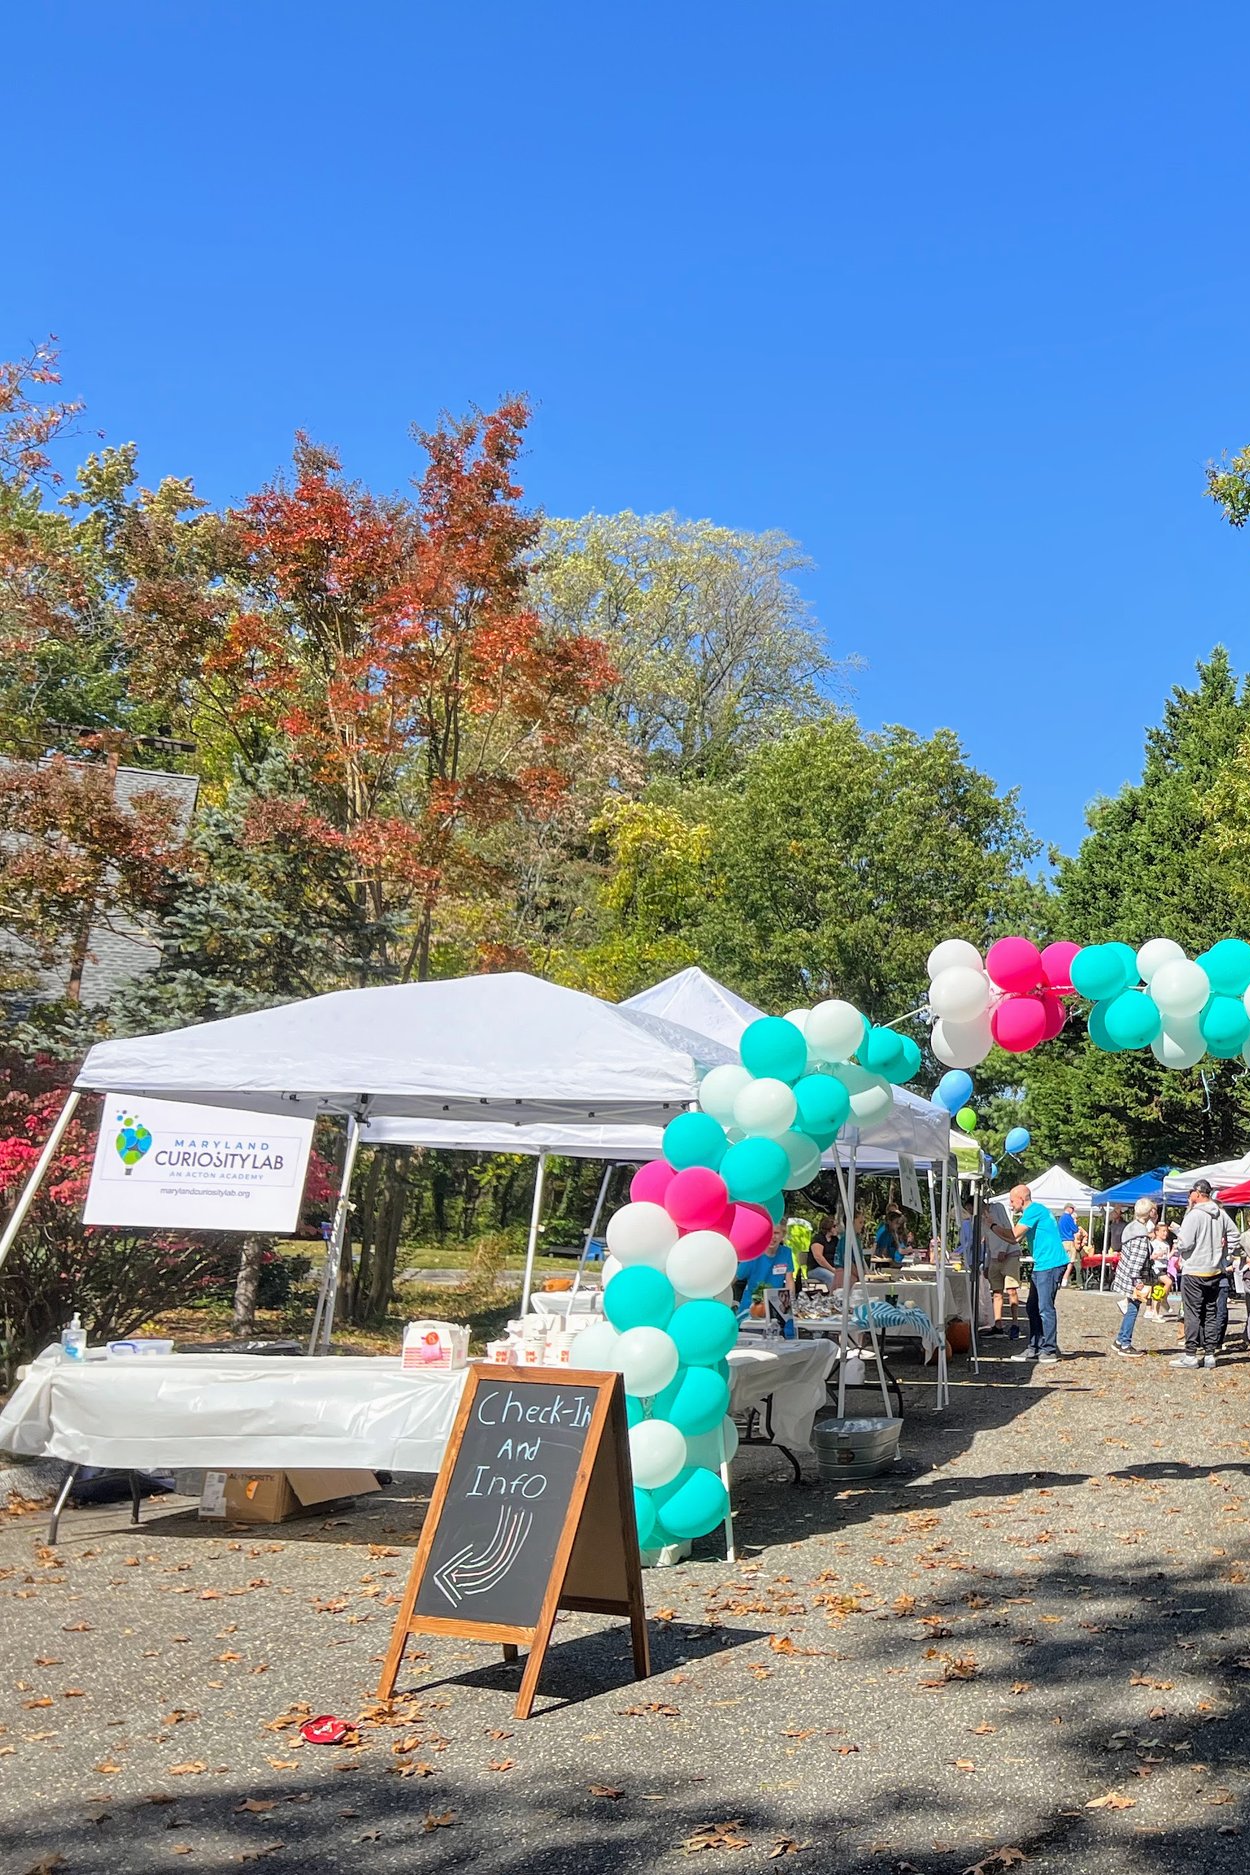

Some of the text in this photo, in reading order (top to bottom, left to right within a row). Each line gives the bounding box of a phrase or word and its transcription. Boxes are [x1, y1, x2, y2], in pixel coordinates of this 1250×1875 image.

[174, 1139, 270, 1151] MARYLAND
[185, 1171, 217, 1179] ACTON
[219, 1172, 264, 1180] ACADEMY
[160, 1187, 251, 1199] marylandcuriositylab.org
[478, 1390, 592, 1428] Check-In
[497, 1436, 541, 1462] And
